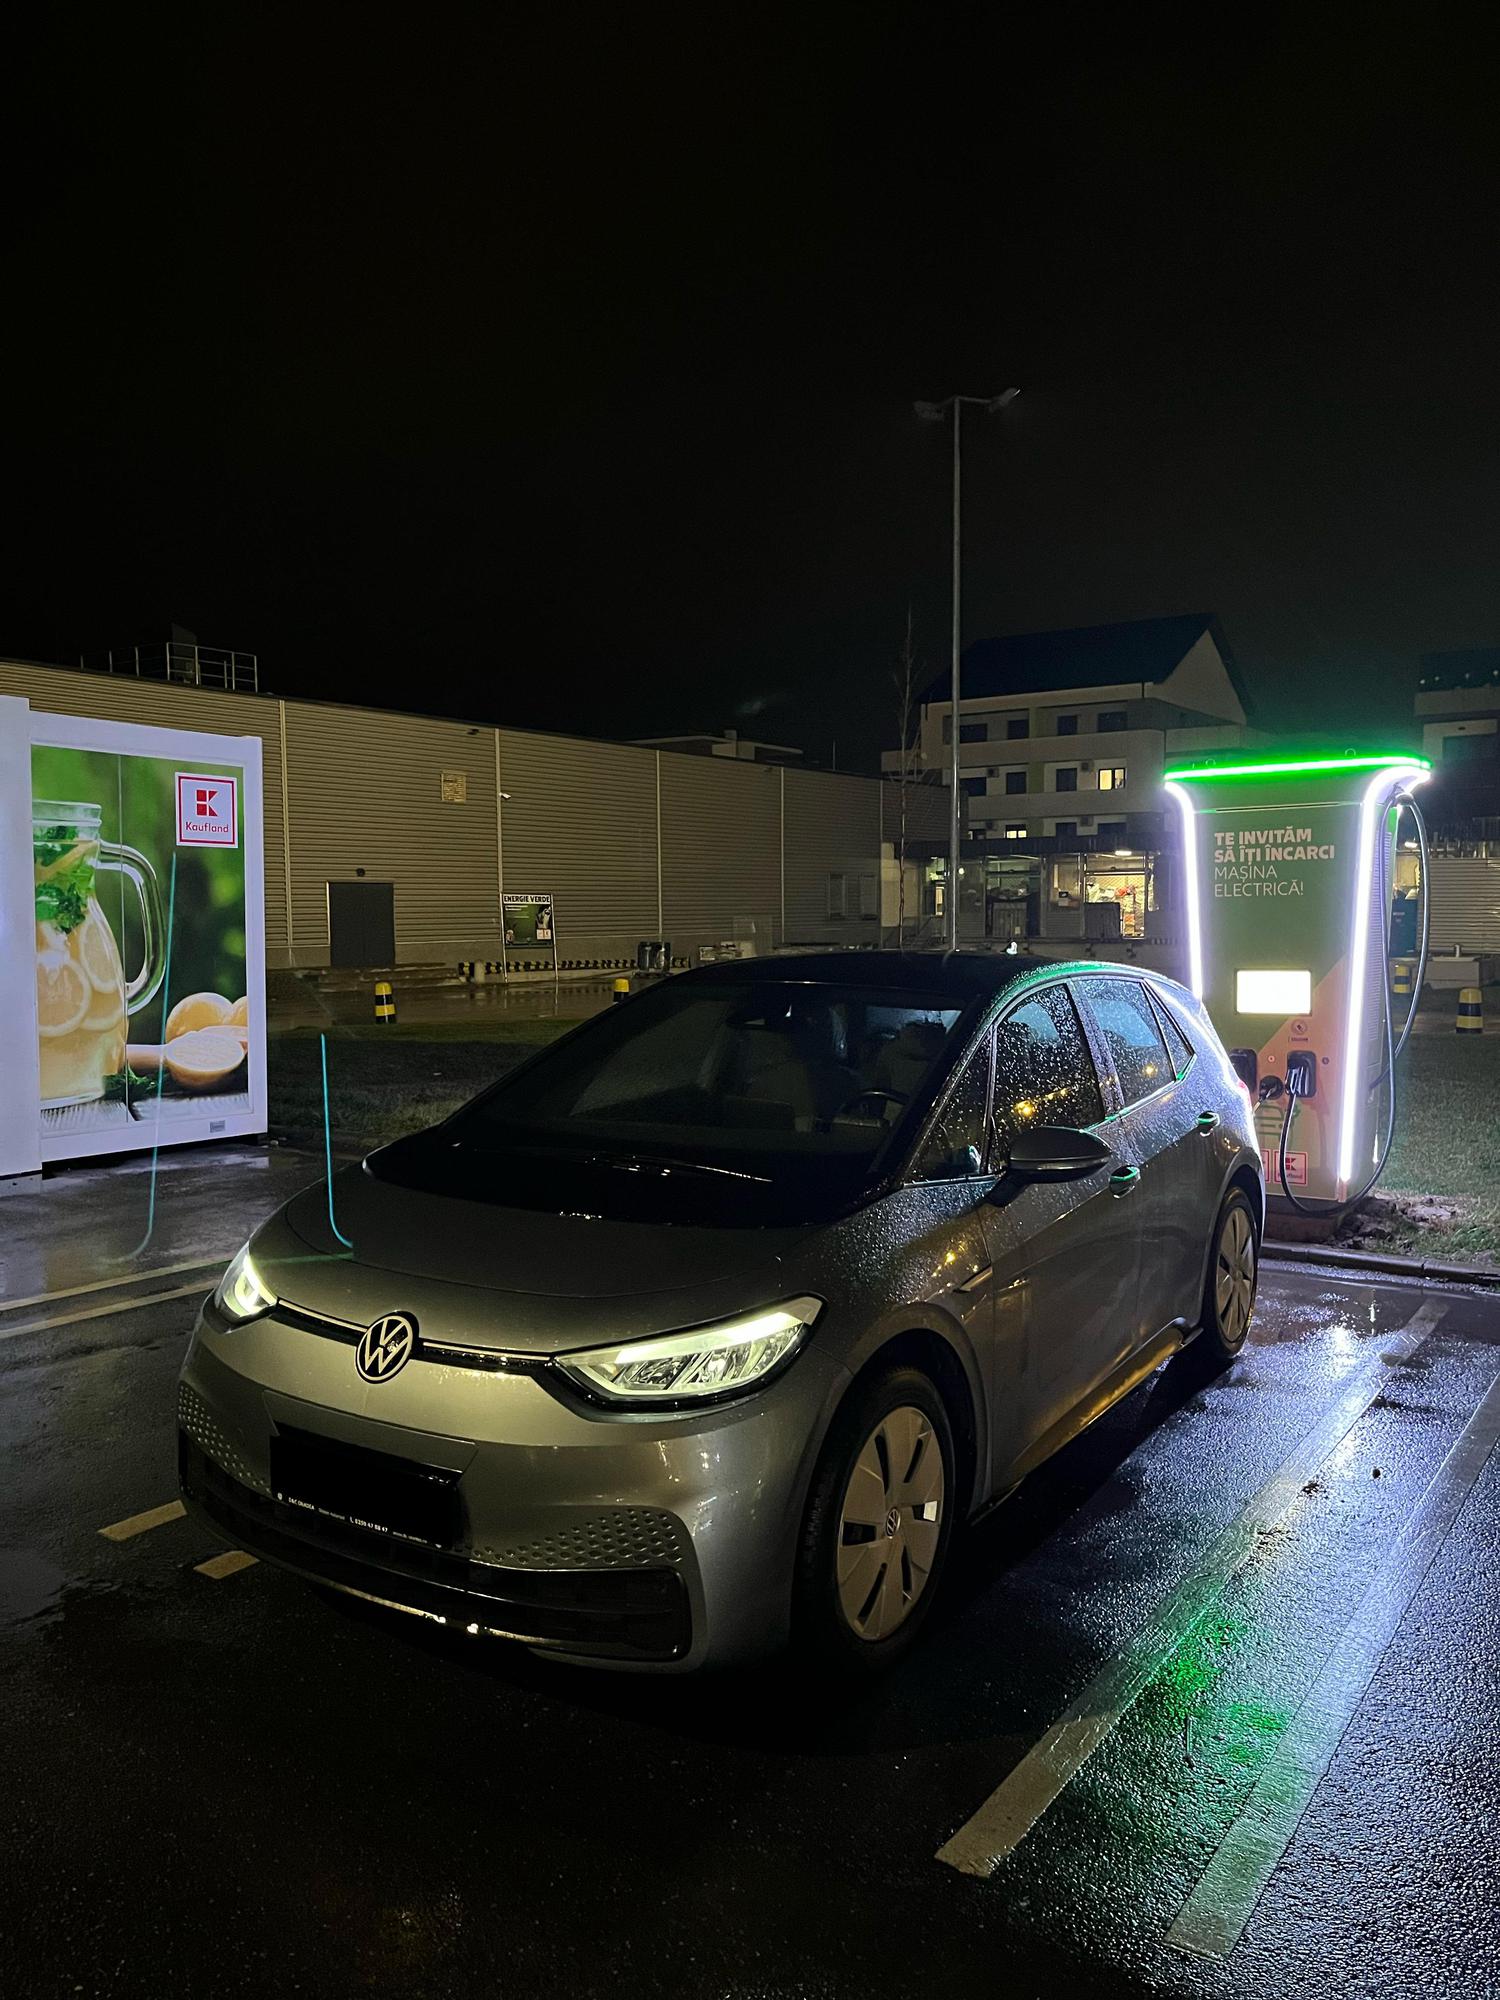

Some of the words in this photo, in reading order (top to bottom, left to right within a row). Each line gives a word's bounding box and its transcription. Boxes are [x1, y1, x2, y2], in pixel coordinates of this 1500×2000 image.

[185, 821, 229, 833] Kaufland
[1214, 832, 1235, 846] TE
[1239, 826, 1312, 844] INVITĂM
[1214, 846, 1236, 863] SĂ
[1265, 844, 1335, 861] ÎNCARCI
[1214, 864, 1278, 882] MAȘINA
[1214, 879, 1304, 897] ELECTRICĂ!
[504, 895, 529, 903] ENERGIE
[530, 895, 550, 903] VERDE
[361, 1316, 411, 1377] VW
